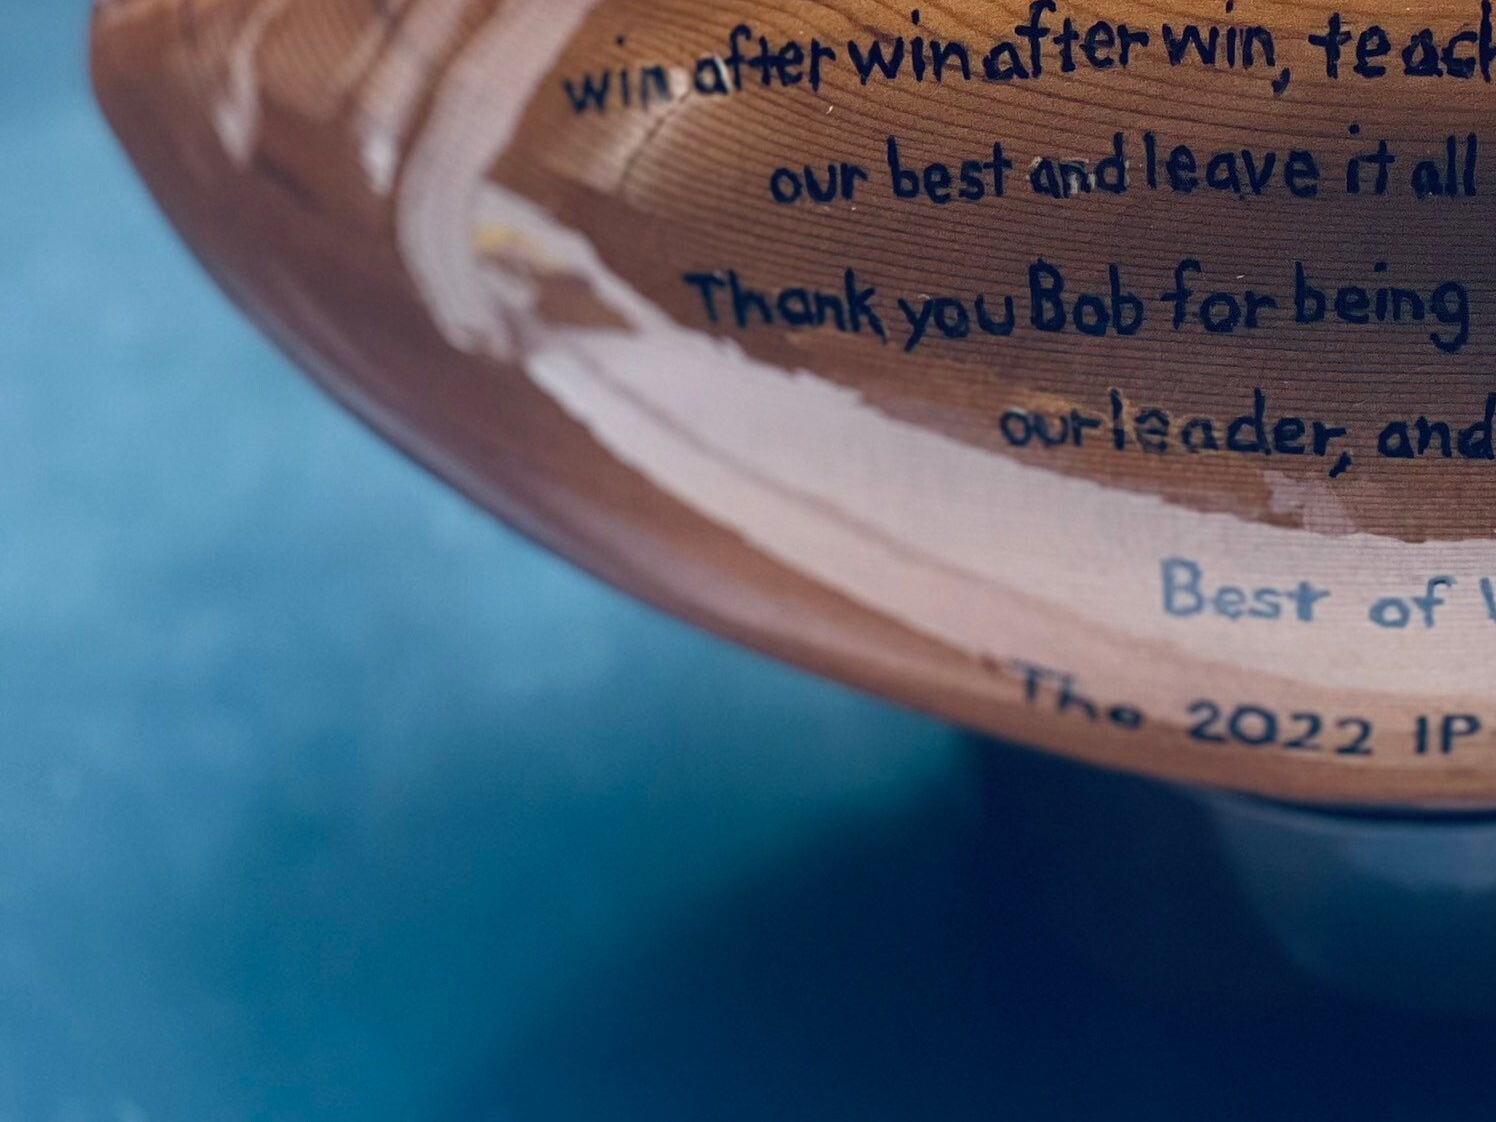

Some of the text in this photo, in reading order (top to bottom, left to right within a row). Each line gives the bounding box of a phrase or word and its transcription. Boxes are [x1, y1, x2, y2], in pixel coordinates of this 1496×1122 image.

[561, 37, 675, 115] win
[694, 22, 837, 100] after
[846, 8, 974, 87] win
[767, 158, 870, 206] our
[885, 133, 1015, 205] best
[1028, 130, 1131, 200] and
[1142, 130, 1323, 201] leave
[1344, 122, 1398, 196] it
[1408, 131, 1479, 202] all
[681, 265, 890, 345] Thank
[898, 292, 1017, 354] you
[1027, 257, 1145, 337] Bob
[1160, 257, 1278, 336] for
[1292, 260, 1471, 355] being
[1000, 406, 1100, 449] our
[1109, 386, 1356, 479] leader,
[1158, 553, 1332, 624] Best
[1367, 573, 1456, 630] of
[1009, 658, 1144, 734] The
[1186, 698, 1374, 757] 2022
[1412, 712, 1483, 756] IP
